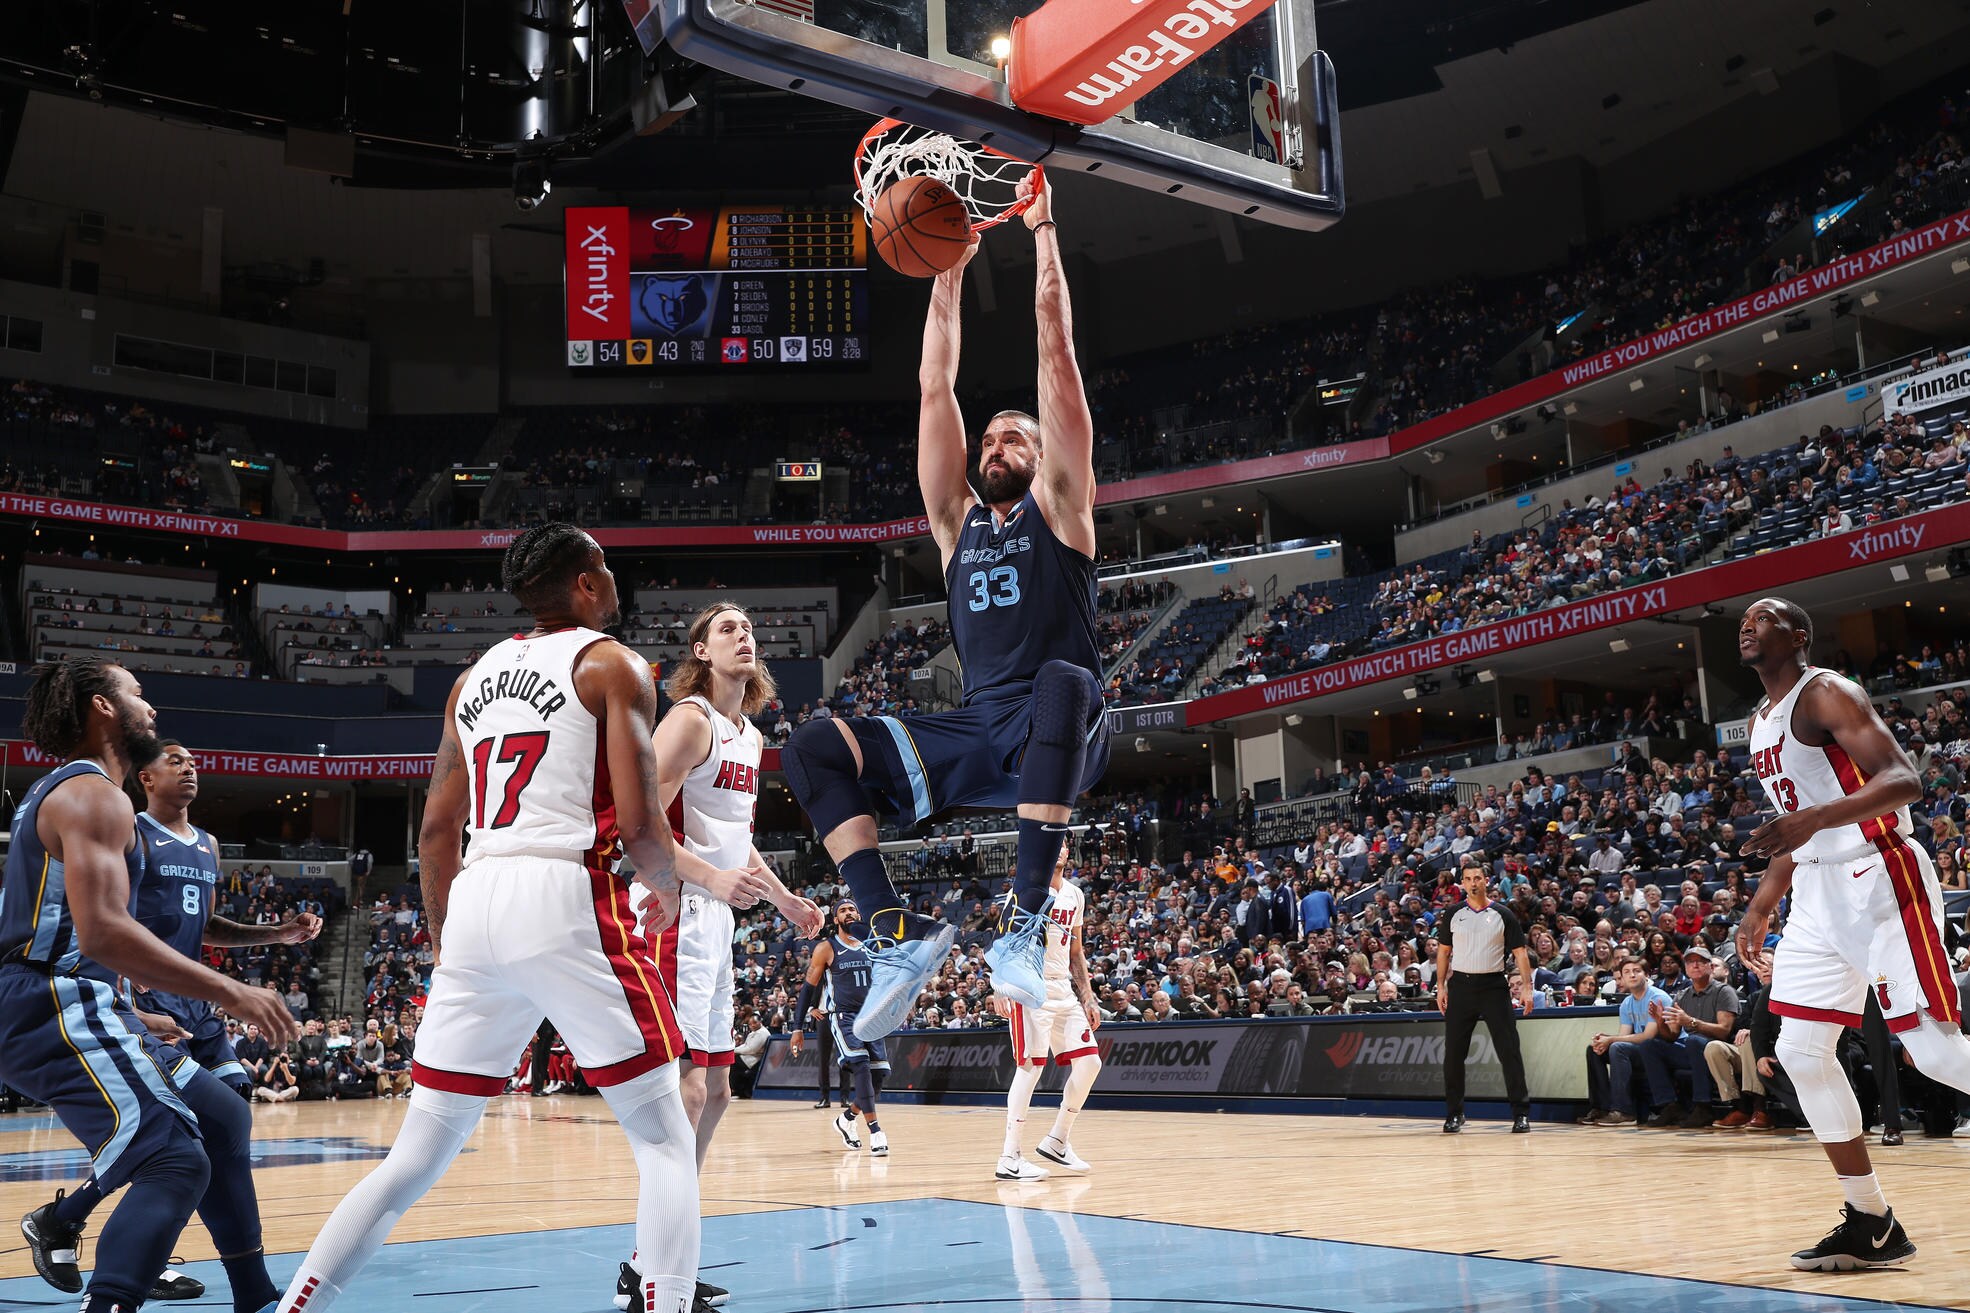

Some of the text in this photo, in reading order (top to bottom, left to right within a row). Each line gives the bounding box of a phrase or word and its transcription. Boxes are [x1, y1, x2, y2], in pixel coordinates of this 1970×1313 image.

[1063, 0, 1252, 106] teFarm
[1256, 142, 1273, 160] NBA
[580, 225, 615, 322] xfinity
[741, 281, 764, 289] GREEN
[741, 303, 769, 311] BROOKS
[1562, 215, 1970, 384] WHILE YOU WATCH THE GAME WITH XFINITY X
[600, 342, 619, 362] 54
[659, 341, 678, 360] 43
[754, 340, 774, 358] 50
[813, 338, 832, 358] 59
[1304, 448, 1346, 466] xfinity
[10, 497, 46, 513] THE
[50, 502, 102, 520] GAME
[106, 510, 151, 526] WITH
[154, 514, 218, 535] XFINITY
[220, 522, 239, 536] X1
[481, 533, 516, 546] xfinit
[754, 520, 931, 541] WHILE YOU WATCH THE GA
[960, 536, 1031, 564] GRIZZLIES
[1849, 523, 1925, 560] xfinity
[968, 565, 1021, 612] 33
[1263, 587, 1667, 703] WHILE YOU WATCH THE GAME WITH XFINITY X1
[458, 668, 566, 732] McGRUDER
[1136, 711, 1174, 726] 1ST QTR
[1726, 727, 1745, 740] 105
[221, 756, 259, 772] THE
[264, 758, 319, 775] GAME
[325, 761, 372, 776] WITH
[377, 760, 436, 774] XFINIT
[473, 730, 550, 830] 17
[1772, 778, 1799, 814] 13
[160, 864, 216, 884] GRIZZLIES
[308, 866, 321, 874] 109
[182, 883, 200, 915] 8
[1050, 907, 1076, 925] EAT
[839, 961, 872, 970] GRIZZLIE
[854, 970, 867, 986] 11
[1120, 1068, 1159, 1083] driving
